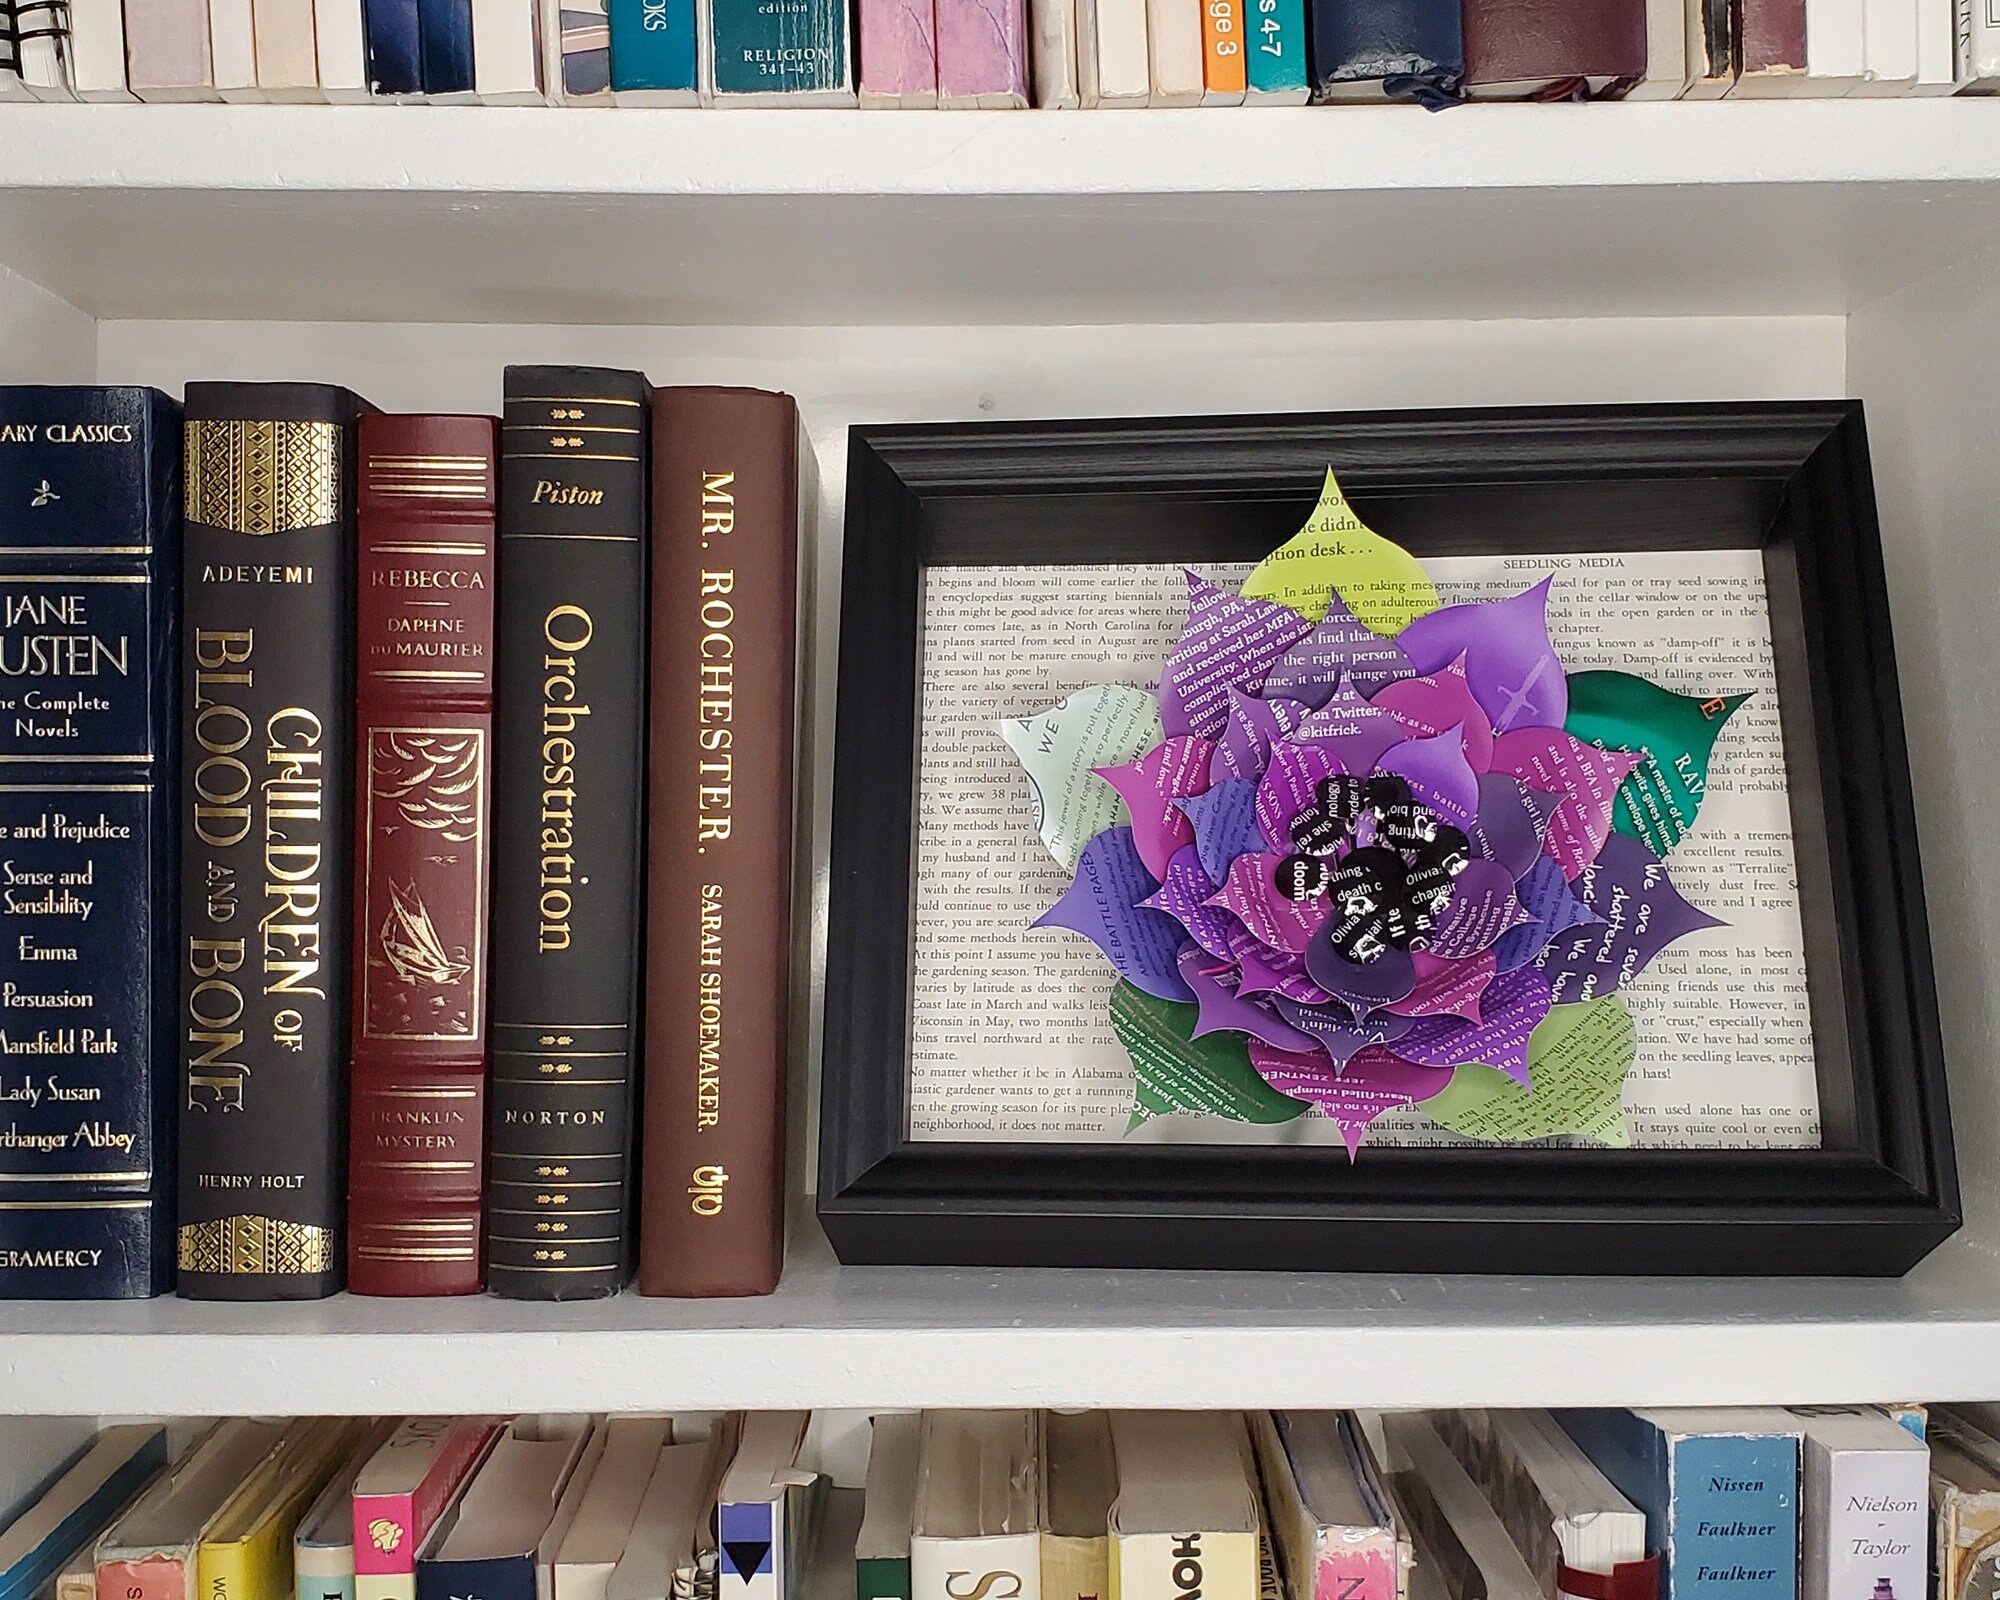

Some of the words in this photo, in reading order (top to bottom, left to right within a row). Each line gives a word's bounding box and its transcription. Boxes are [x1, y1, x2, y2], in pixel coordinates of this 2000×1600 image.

[759, 2, 807, 13] edition
[1261, 19, 1281, 56] 4-7
[744, 48, 829, 62] RELIGION
[1217, 42, 1237, 55] 3
[46, 424, 132, 442] CLASSICS
[531, 480, 604, 506] Piston
[701, 470, 736, 549] MR.
[1311, 542, 1346, 556] desk
[1504, 559, 1571, 569] SEEDLING
[1579, 558, 1624, 568] MEDIA
[202, 565, 315, 584] ADEYEMI
[371, 568, 486, 591] REBECCA
[939, 577, 972, 589] begins
[1003, 576, 1035, 587] bloom
[1101, 576, 1135, 587] earlier
[1707, 576, 1748, 588] sowing
[942, 592, 1013, 604] encyclopedias
[1021, 593, 1059, 604] suggest
[1115, 590, 1162, 601] biennials
[1285, 587, 1296, 597] In
[1370, 580, 1406, 593] taking
[1636, 591, 1679, 602] window
[1041, 605, 1073, 616] advice
[1221, 601, 1245, 619] PA,
[1362, 599, 1376, 608] on
[1381, 596, 1438, 607] adulterous
[6, 595, 88, 628] JANE
[1657, 607, 1694, 619] garden
[387, 618, 465, 634] DAPHNE
[1065, 620, 1097, 631] North
[1105, 620, 1150, 631] Carolina
[1558, 623, 1604, 636] chapter.
[943, 637, 975, 649] plants
[981, 636, 1015, 646] started
[1098, 636, 1136, 647] August
[1166, 641, 1208, 668] writing
[1208, 635, 1222, 645] at
[1222, 617, 1254, 638] Sarah
[1318, 630, 1345, 643] find
[1350, 629, 1376, 642] that
[1550, 638, 1590, 652] fungus
[0, 635, 128, 676] USTEN
[394, 643, 485, 658] MAURIER
[1030, 653, 1066, 661] mature
[1172, 667, 1195, 684] and
[1196, 640, 1244, 672] received
[1246, 631, 1266, 647] her
[1267, 613, 1294, 634] MFA
[1177, 663, 1239, 698] University.
[1239, 641, 1275, 664] When
[1275, 629, 1297, 647] she
[1283, 653, 1306, 666] the
[1312, 651, 1345, 665] right
[1352, 650, 1397, 665] person
[1623, 653, 1678, 665] Damp-off
[1699, 653, 1753, 663] evidenced
[1013, 680, 1048, 691] several
[1298, 673, 1306, 684] it
[1312, 670, 1335, 683] will
[24, 691, 111, 714] Complete
[697, 568, 735, 854] ROCHESTER.
[1701, 698, 1727, 720] E
[1312, 710, 1329, 721] on
[1332, 706, 1382, 720] Twitter,
[14, 716, 79, 738] Novels
[1037, 718, 1060, 754] WE
[1195, 716, 1228, 739] fiction
[1298, 722, 1362, 740] @kitfrick.
[194, 627, 254, 847] BLOOD
[955, 773, 1010, 783] introduced
[1531, 755, 1550, 783] novel
[1580, 763, 1599, 784] BFA
[539, 604, 594, 955] Orchestration
[1653, 770, 1675, 806] master
[992, 789, 1005, 799] 38
[1432, 791, 1468, 818] battle
[1620, 786, 1647, 834] envelope
[1641, 792, 1660, 821] gives
[13, 813, 47, 839] and
[53, 813, 131, 844] Prejudice
[977, 836, 1016, 848] general
[1684, 846, 1735, 856] excellent
[258, 707, 327, 1001] CHILDREN
[945, 852, 989, 862] husband
[3, 859, 54, 885] Sense
[59, 859, 94, 885] and
[1643, 863, 1664, 891] We
[206, 861, 237, 923] AND
[1337, 884, 1371, 903] death
[3, 888, 94, 921] Sensibility
[700, 884, 723, 966] SARAH
[1097, 900, 1122, 948] BATTLE
[1595, 885, 1631, 964] shattered
[18, 935, 78, 961] Emma
[1567, 938, 1592, 961] We
[931, 965, 987, 978] gardening
[991, 967, 1030, 977] season.
[3, 981, 94, 1008] Persuasion
[973, 982, 1014, 992] latitude
[1551, 971, 1576, 1003] have
[1678, 981, 1718, 991] friends
[986, 999, 1022, 1009] March
[1672, 997, 1722, 1010] suitable.
[1729, 999, 1787, 1011] However,
[187, 936, 252, 1114] BONE
[273, 1009, 304, 1053] OF
[986, 1016, 1013, 1029] May,
[1709, 1016, 1766, 1029] especially
[82, 1028, 119, 1055] Park
[984, 1033, 1041, 1043] northward
[696, 973, 723, 1134] SHOEMAKER.
[1682, 1050, 1731, 1064] seedling
[1072, 1067, 1123, 1078] Alabama
[1643, 1068, 1670, 1078] hats!
[0, 1075, 42, 1109] Lady
[47, 1075, 101, 1102] Susan
[951, 1102, 999, 1115] growing
[505, 1110, 606, 1126] NORTON
[913, 1118, 994, 1132] neighborhood,
[1065, 1120, 1106, 1132] matter.
[0, 1121, 68, 1152] rthanger
[72, 1121, 137, 1154] Abbey
[1685, 1121, 1716, 1136] quite
[375, 1134, 458, 1149] MYSTERY
[198, 1174, 254, 1189] HENRY
[260, 1174, 306, 1190] HOLT
[1708, 1475, 1765, 1495] Nissen
[1846, 1495, 1919, 1514] Nielson
[1697, 1519, 1777, 1539] Faulkner
[1851, 1538, 1912, 1558] Taylor
[1697, 1564, 1777, 1584] Faulkner
